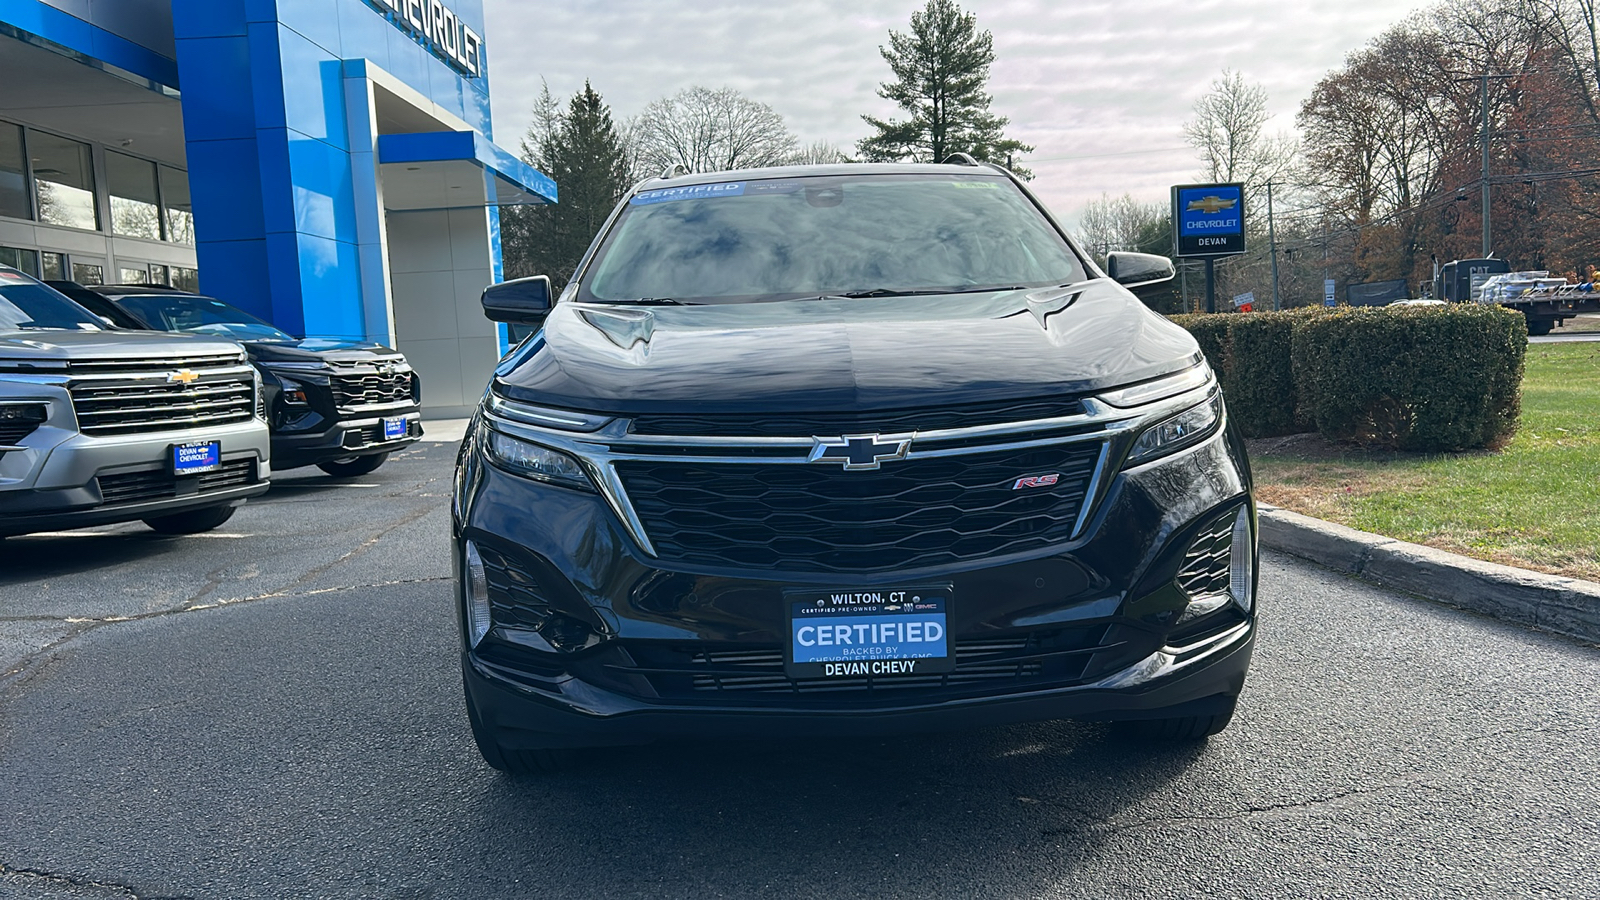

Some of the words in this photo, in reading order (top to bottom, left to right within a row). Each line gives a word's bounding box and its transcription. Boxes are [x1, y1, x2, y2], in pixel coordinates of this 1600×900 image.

[383, 0, 481, 78] EVROLET
[637, 184, 739, 199] CERTIFIED
[1186, 219, 1237, 229] CHEVROLET
[1198, 237, 1227, 246] DEVAN
[1469, 266, 1490, 274] CAT
[180, 453, 208, 462] CHEVROLET
[1012, 474, 1059, 489] RS
[831, 592, 885, 605] WILTON,
[889, 591, 906, 603] CT
[797, 622, 943, 646] CERTIFIED
[843, 647, 882, 656] BACKED
[885, 646, 899, 654] BY
[825, 662, 869, 676] DEVAN
[872, 660, 916, 673] CHEVY
